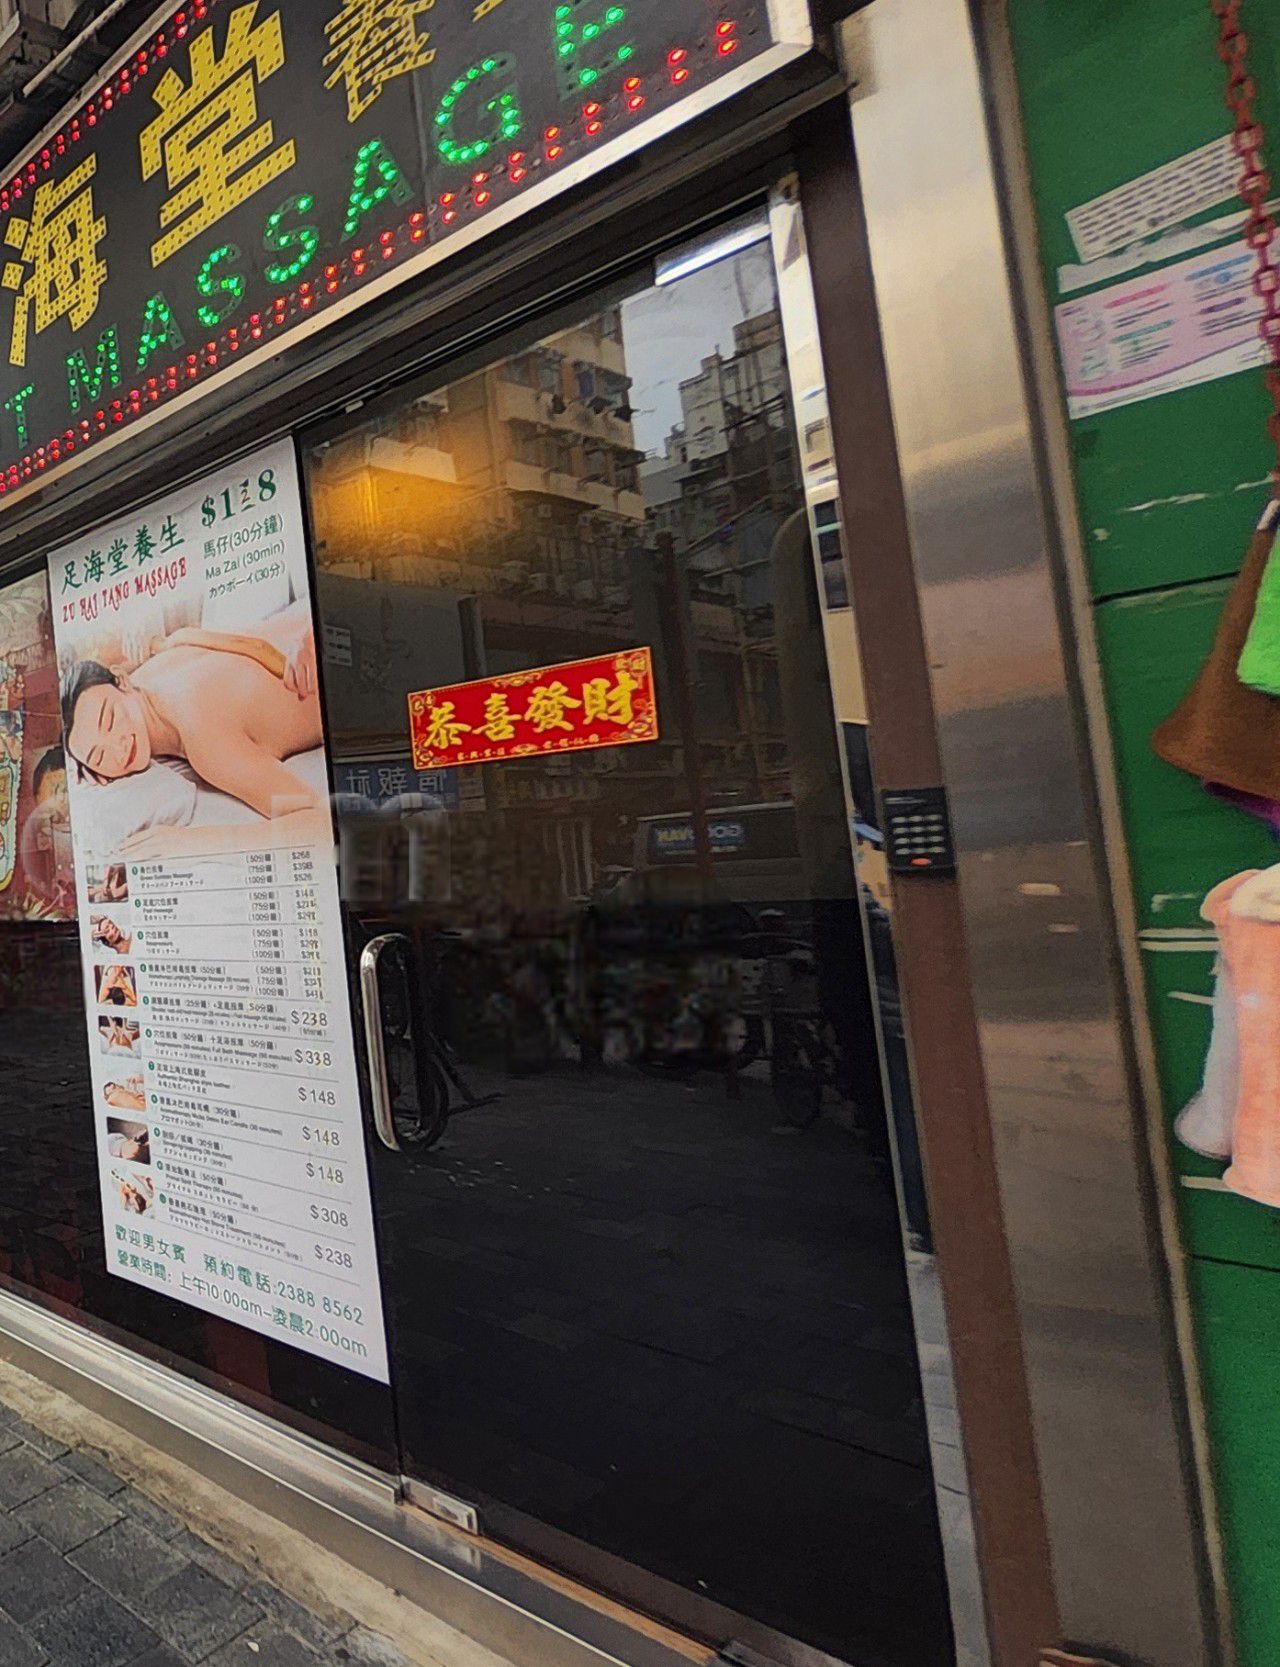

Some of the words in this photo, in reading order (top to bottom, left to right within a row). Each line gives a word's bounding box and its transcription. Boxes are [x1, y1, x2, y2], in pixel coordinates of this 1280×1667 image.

[65, 0, 635, 415] MASSAGE
[203, 513, 283, 560] 馬仔(30分鐘)
[60, 515, 185, 596] 足海堂養生
[205, 564, 223, 580] Ma
[243, 539, 285, 570] (30min)
[100, 581, 131, 612] TANG
[135, 556, 187, 597] MASSAGE
[424, 670, 639, 749] 恭喜發財
[290, 1010, 328, 1027] $238
[294, 1049, 332, 1067] $338
[297, 1086, 336, 1106] $148
[302, 1125, 341, 1147] $148
[306, 1162, 345, 1185] $148
[310, 1204, 349, 1228] $308
[314, 1244, 352, 1269] $238
[115, 1223, 186, 1264] 歡迎男女賓
[322, 1296, 364, 1326] 8562
